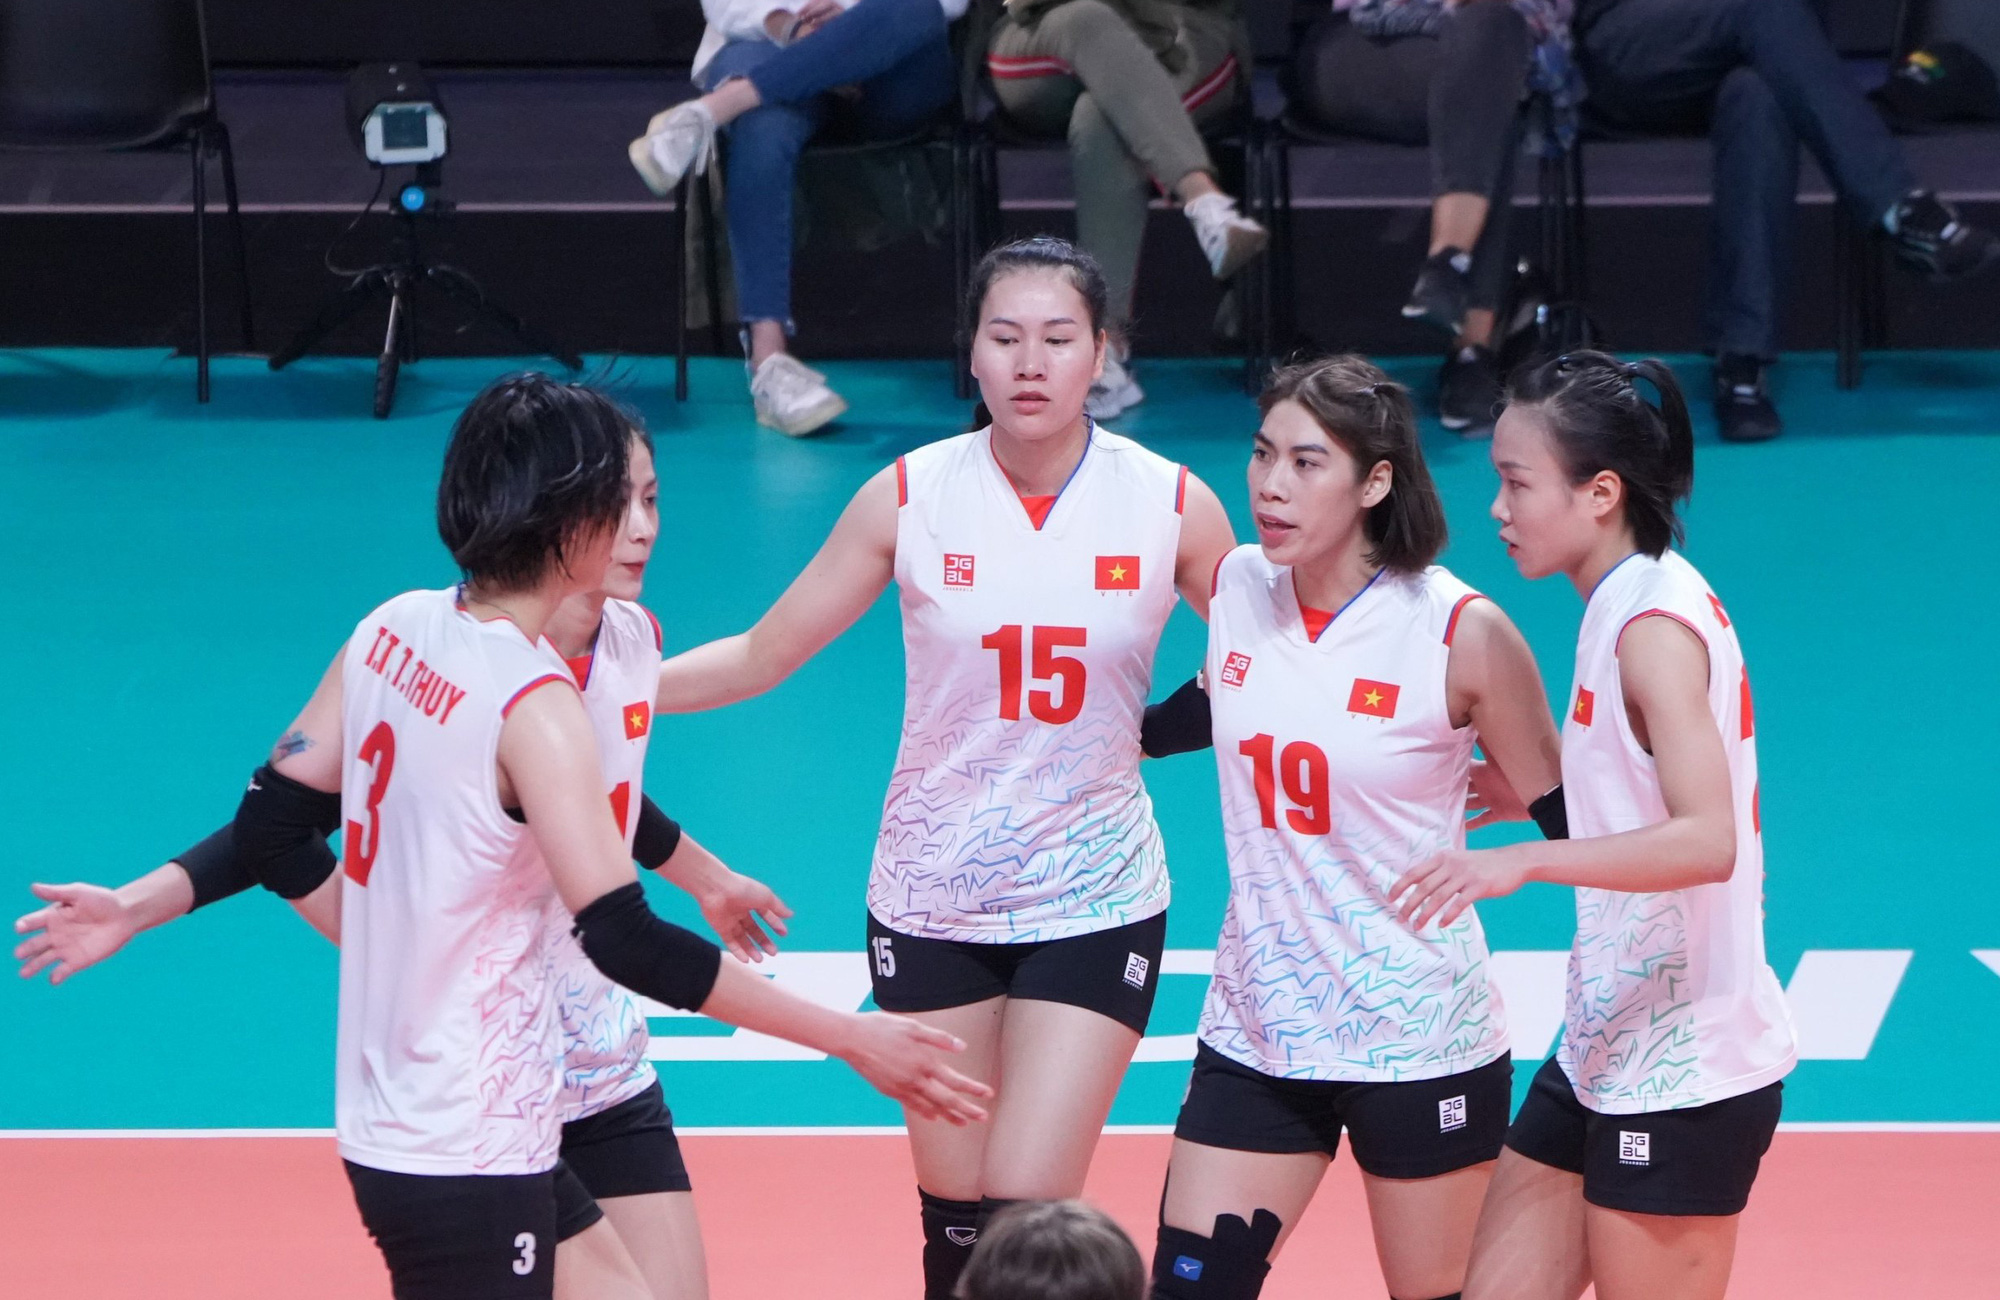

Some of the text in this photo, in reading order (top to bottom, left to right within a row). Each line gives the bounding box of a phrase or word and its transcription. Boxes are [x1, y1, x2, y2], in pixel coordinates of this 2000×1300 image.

[982, 624, 1086, 724] 15
[344, 720, 395, 888] 3
[1239, 733, 1331, 835] 19
[872, 936, 896, 978] 15
[512, 1231, 536, 1275] 3
